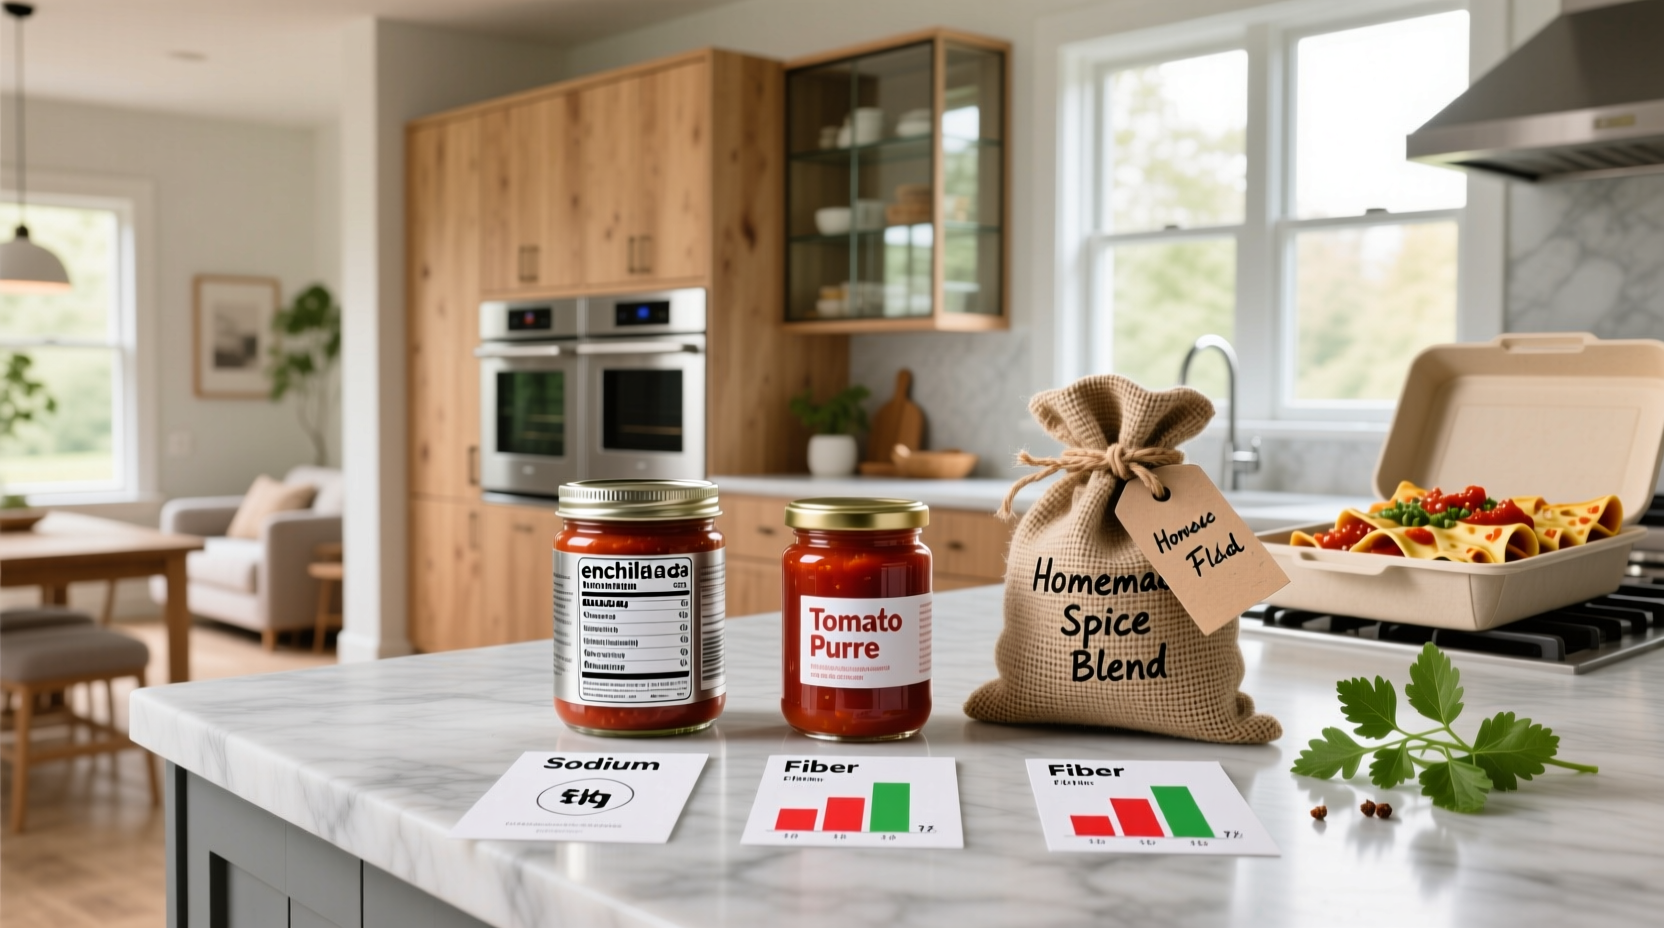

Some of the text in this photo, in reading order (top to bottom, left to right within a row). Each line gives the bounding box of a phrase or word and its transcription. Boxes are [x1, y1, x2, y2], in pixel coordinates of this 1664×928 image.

[809, 607, 903, 632] Tomato
[1060, 603, 1151, 649] Spice
[810, 634, 880, 659] Purre
[1071, 642, 1168, 682] Blend
[543, 757, 660, 771] Sodium
[784, 759, 860, 774] Fiber
[1048, 763, 1125, 778] Fiber
